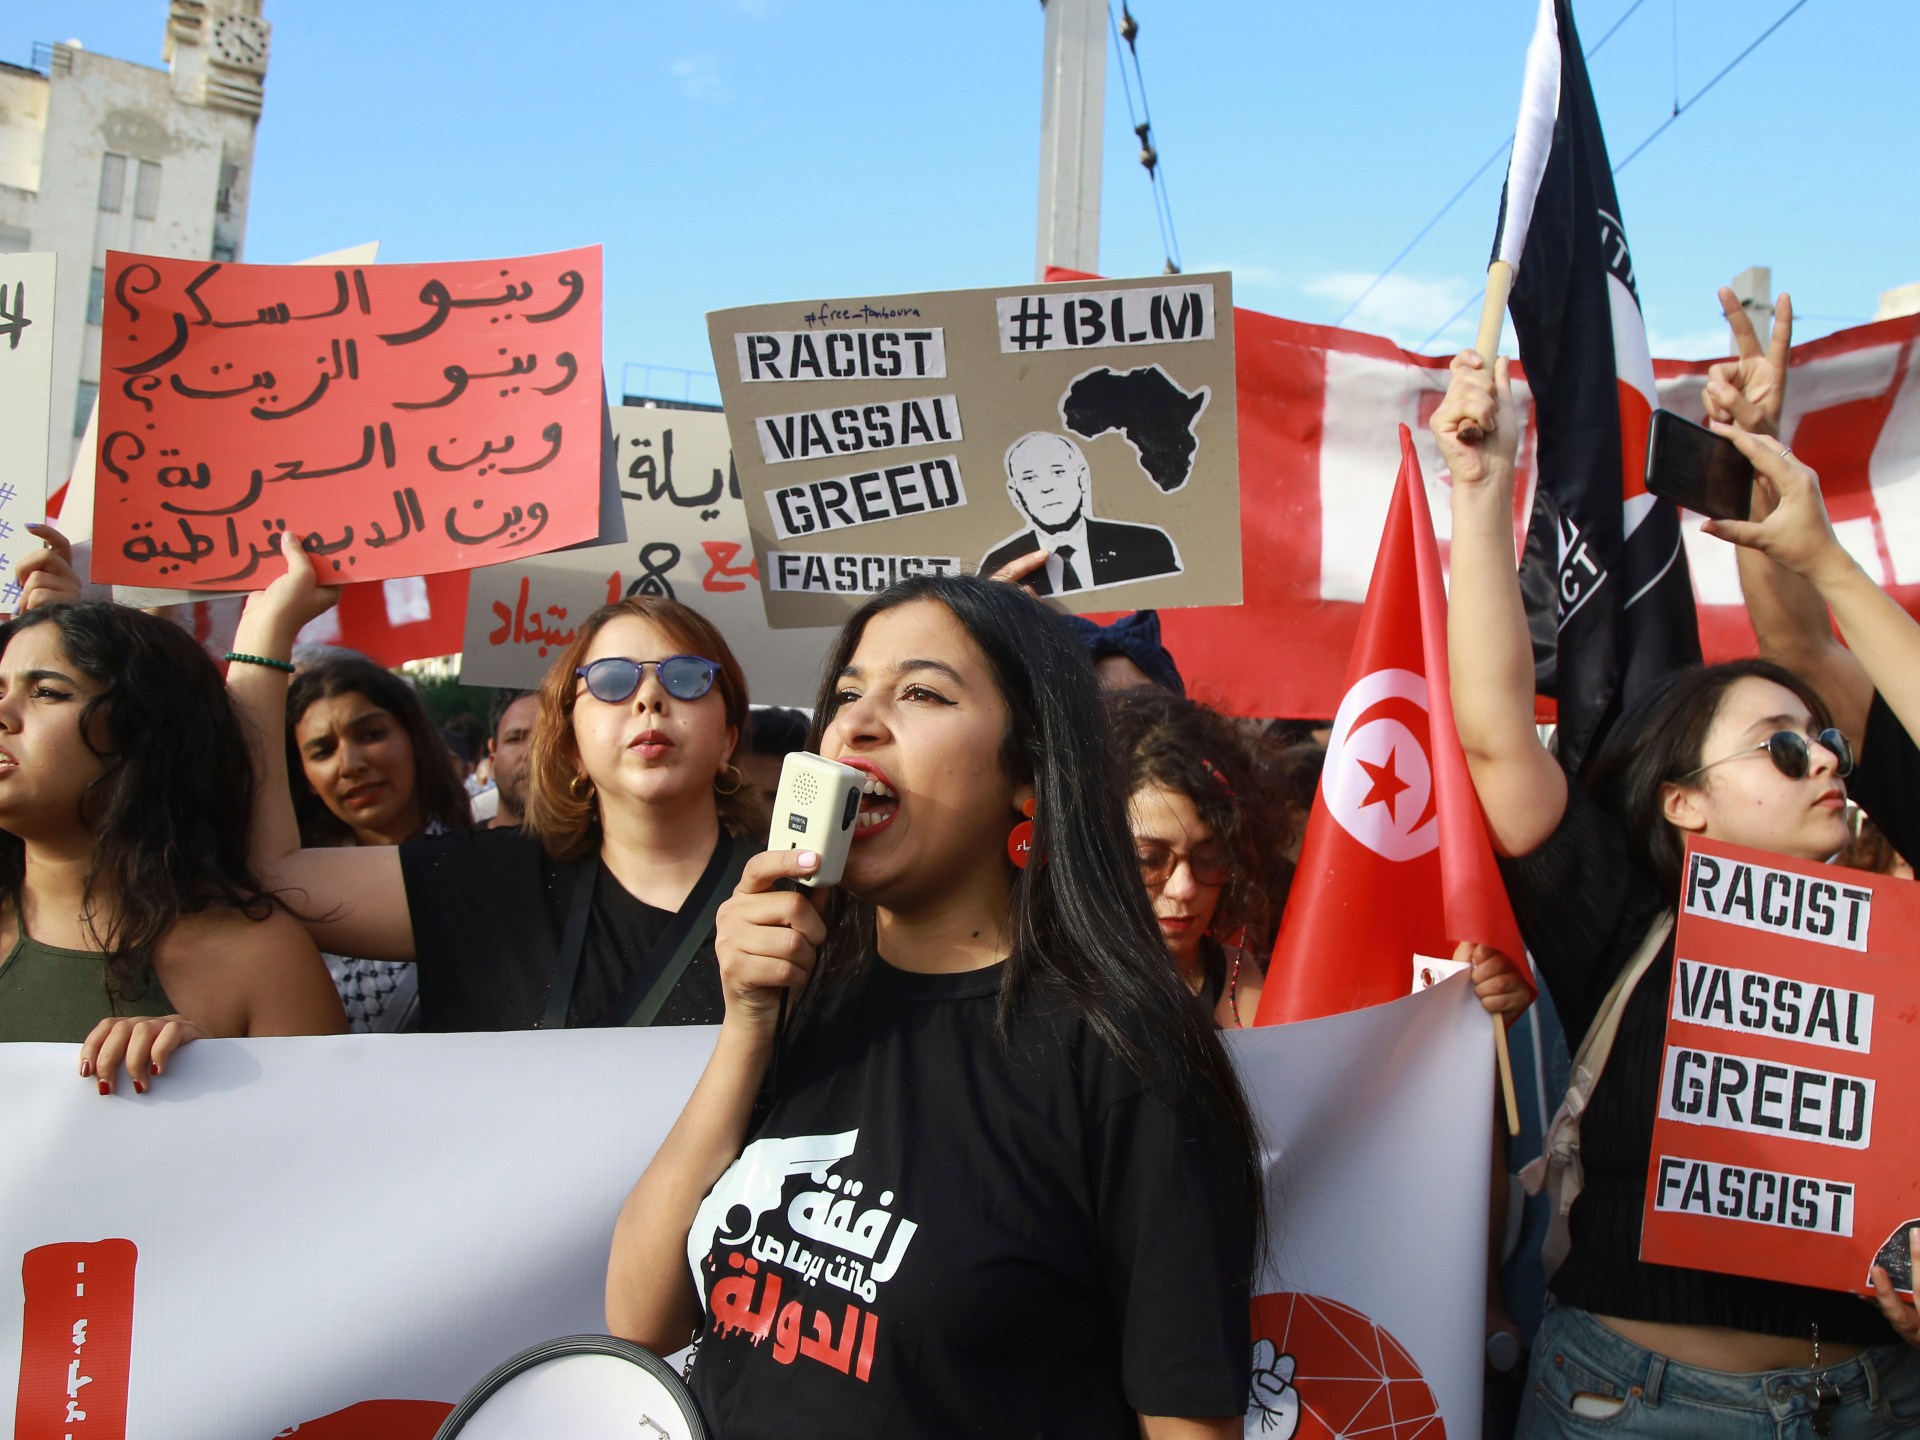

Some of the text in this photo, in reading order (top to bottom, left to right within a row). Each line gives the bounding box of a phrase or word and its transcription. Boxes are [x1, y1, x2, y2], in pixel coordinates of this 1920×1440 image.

[375, 270, 584, 346] وينو
[1010, 292, 1203, 350] #BLM
[391, 350, 578, 410] وينو
[746, 331, 933, 379] RACIST
[427, 421, 563, 477] وين
[776, 458, 961, 535] GREED
[121, 486, 549, 585] وين الديمقراطية
[1686, 854, 1871, 942] RACIST
[1671, 1050, 1866, 1142] GREED
[1656, 1158, 1853, 1233] FASCIST
[710, 1251, 879, 1383] الدولة
